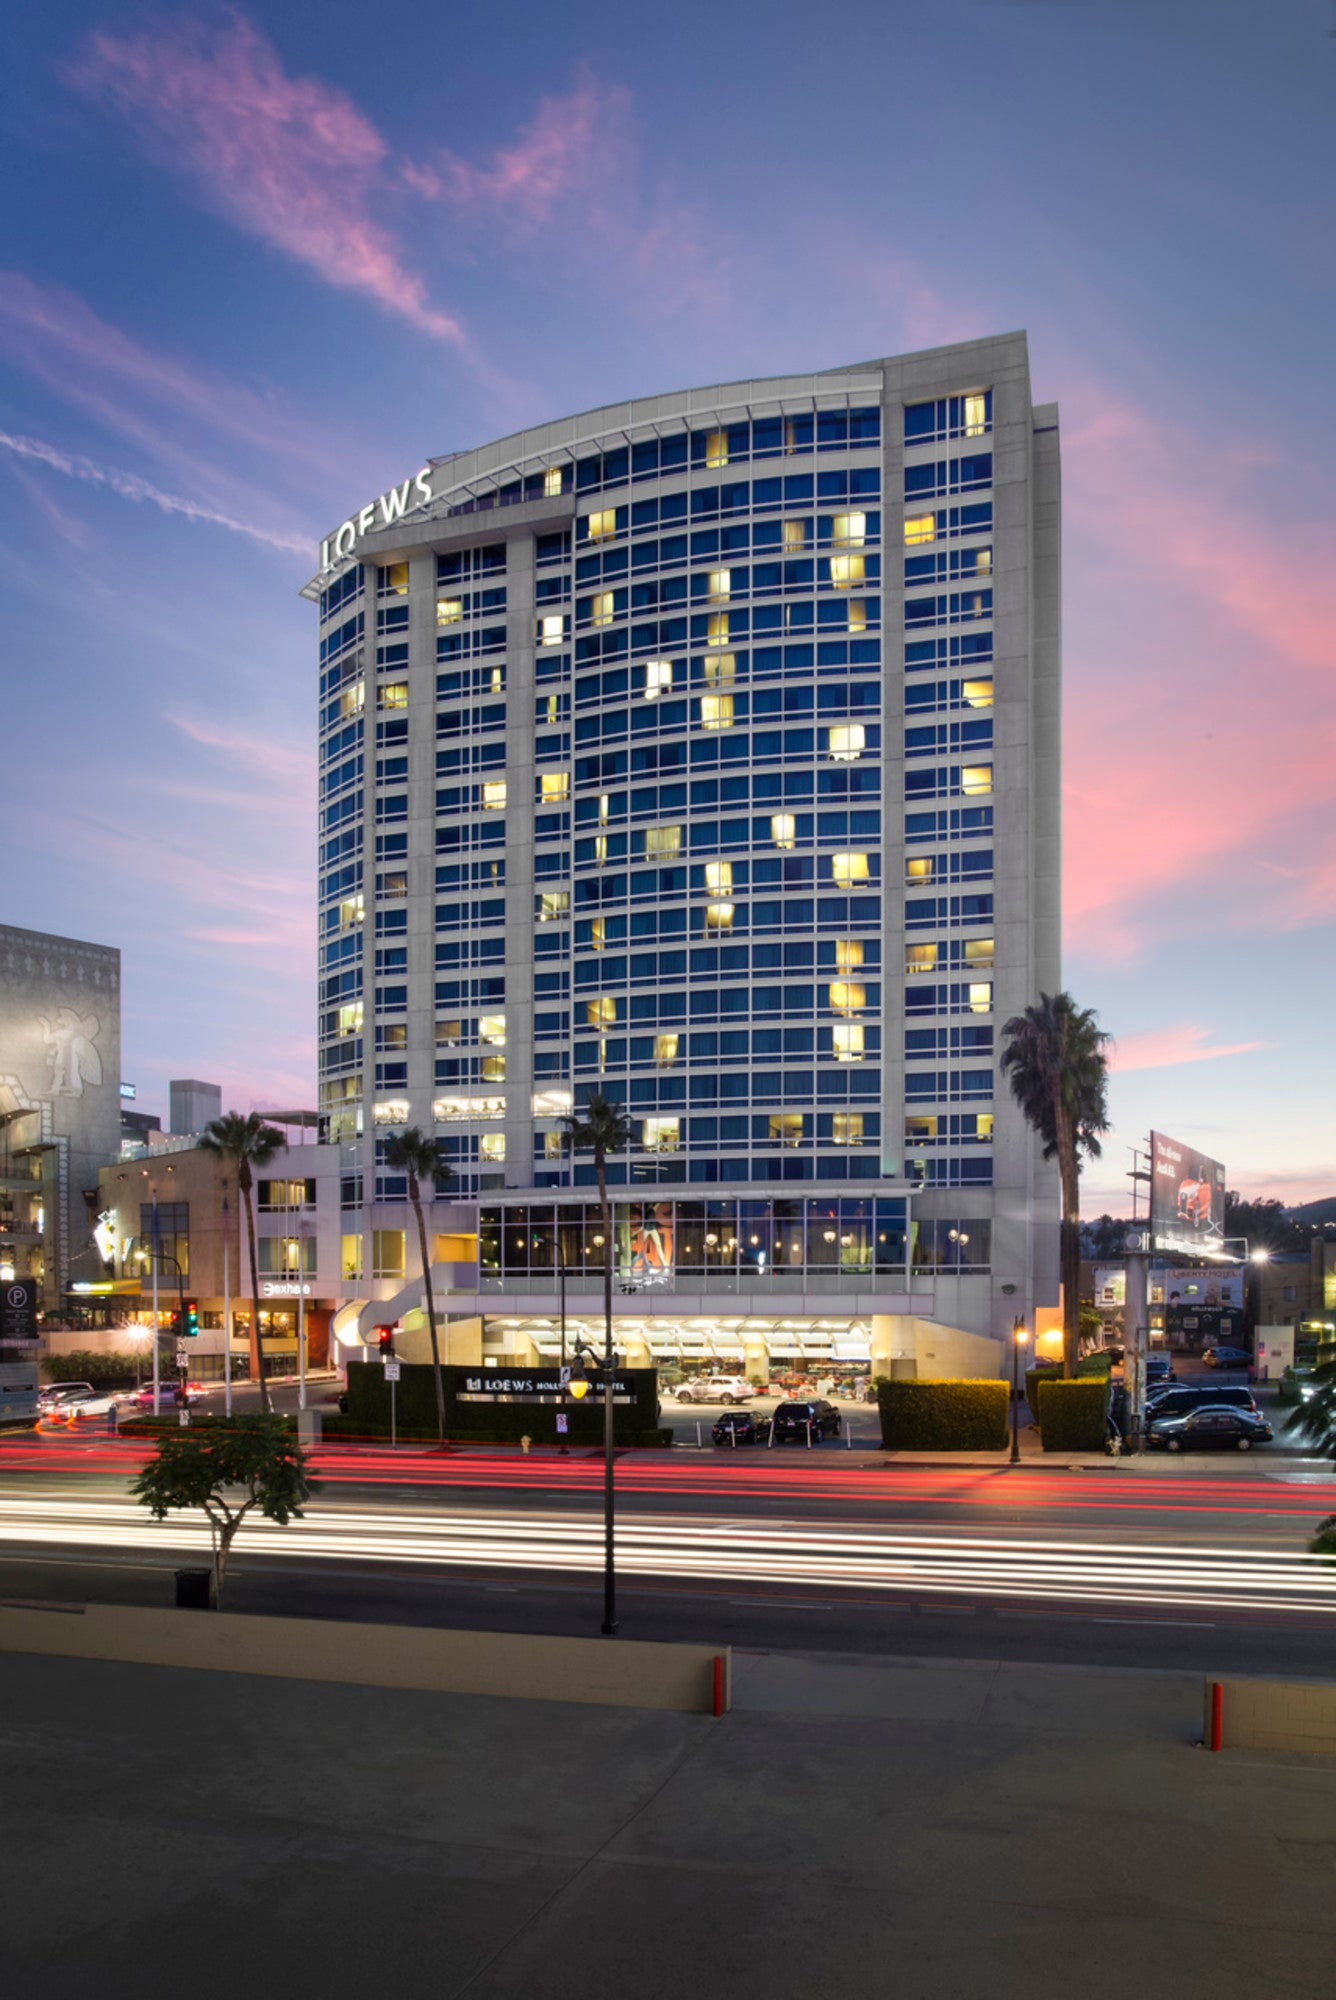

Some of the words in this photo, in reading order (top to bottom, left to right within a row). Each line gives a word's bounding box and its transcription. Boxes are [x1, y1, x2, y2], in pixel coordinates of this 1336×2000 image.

[322, 467, 432, 573] LOEWS
[274, 1283, 311, 1295] exhae
[484, 1379, 533, 1392] LOEWS
[596, 1382, 625, 1390] HTEL
